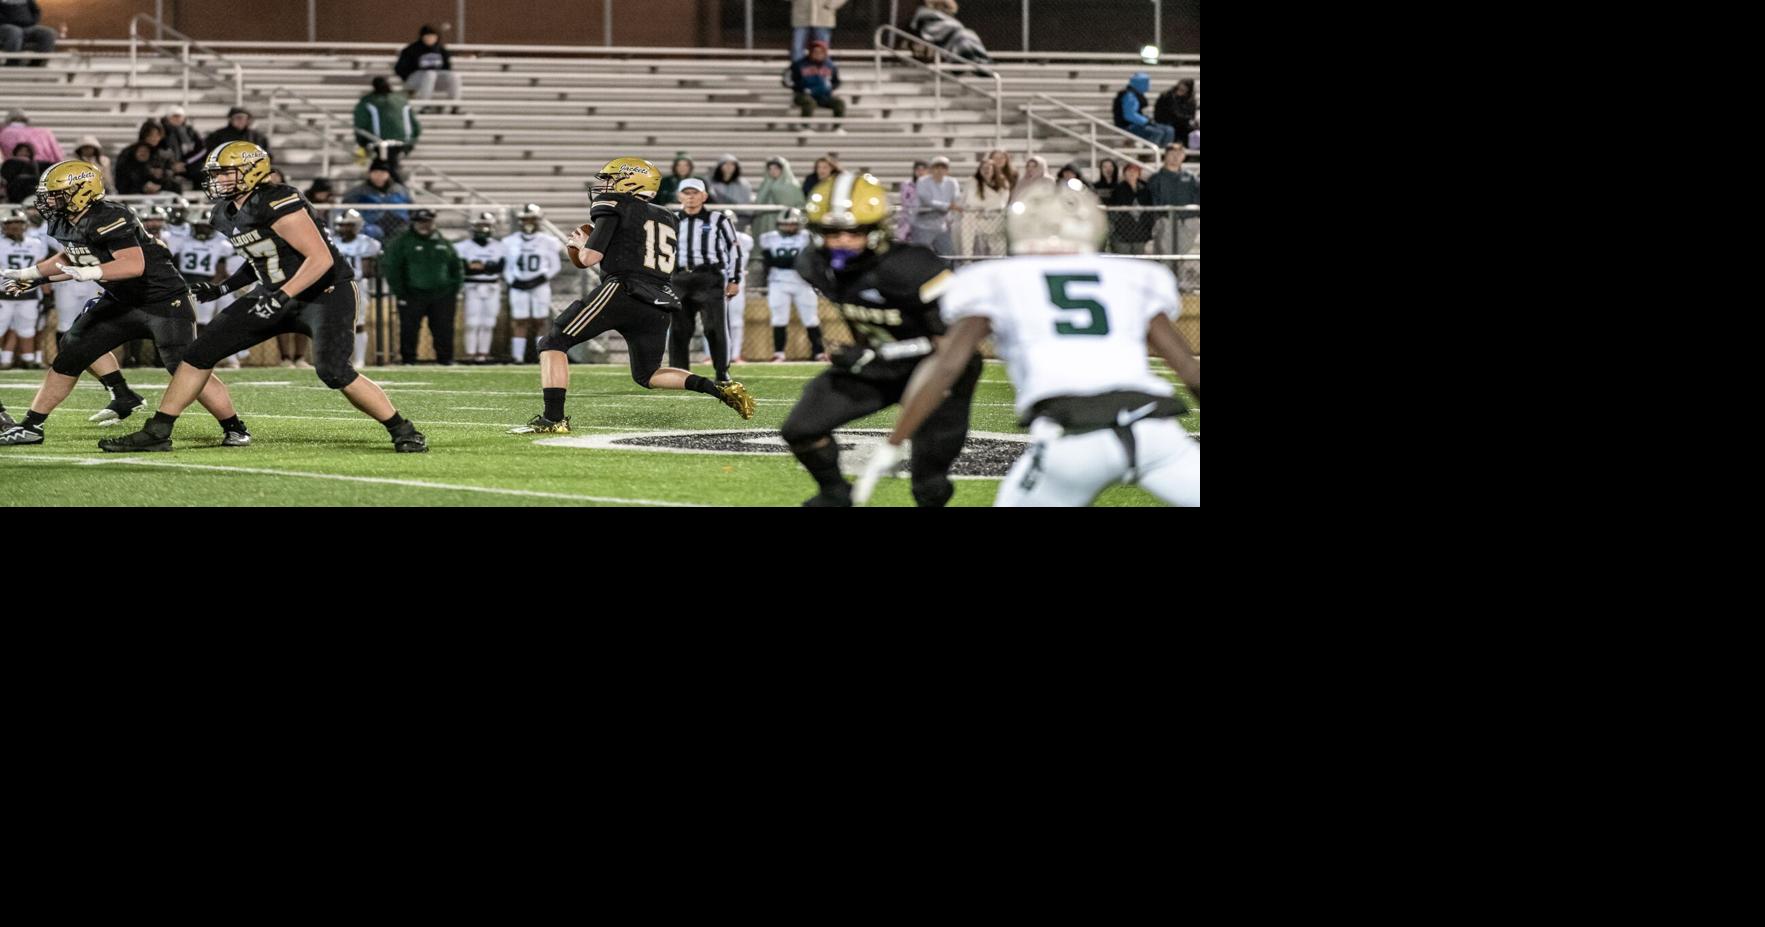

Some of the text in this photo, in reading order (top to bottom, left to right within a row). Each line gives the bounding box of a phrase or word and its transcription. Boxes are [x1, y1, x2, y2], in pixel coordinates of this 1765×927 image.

[619, 163, 648, 175] Jackets
[67, 171, 96, 186] Jackets
[643, 219, 677, 274] 15
[8, 254, 35, 270] 57
[184, 252, 211, 272] 34
[517, 254, 541, 272] 40
[1044, 274, 1109, 336] 5
